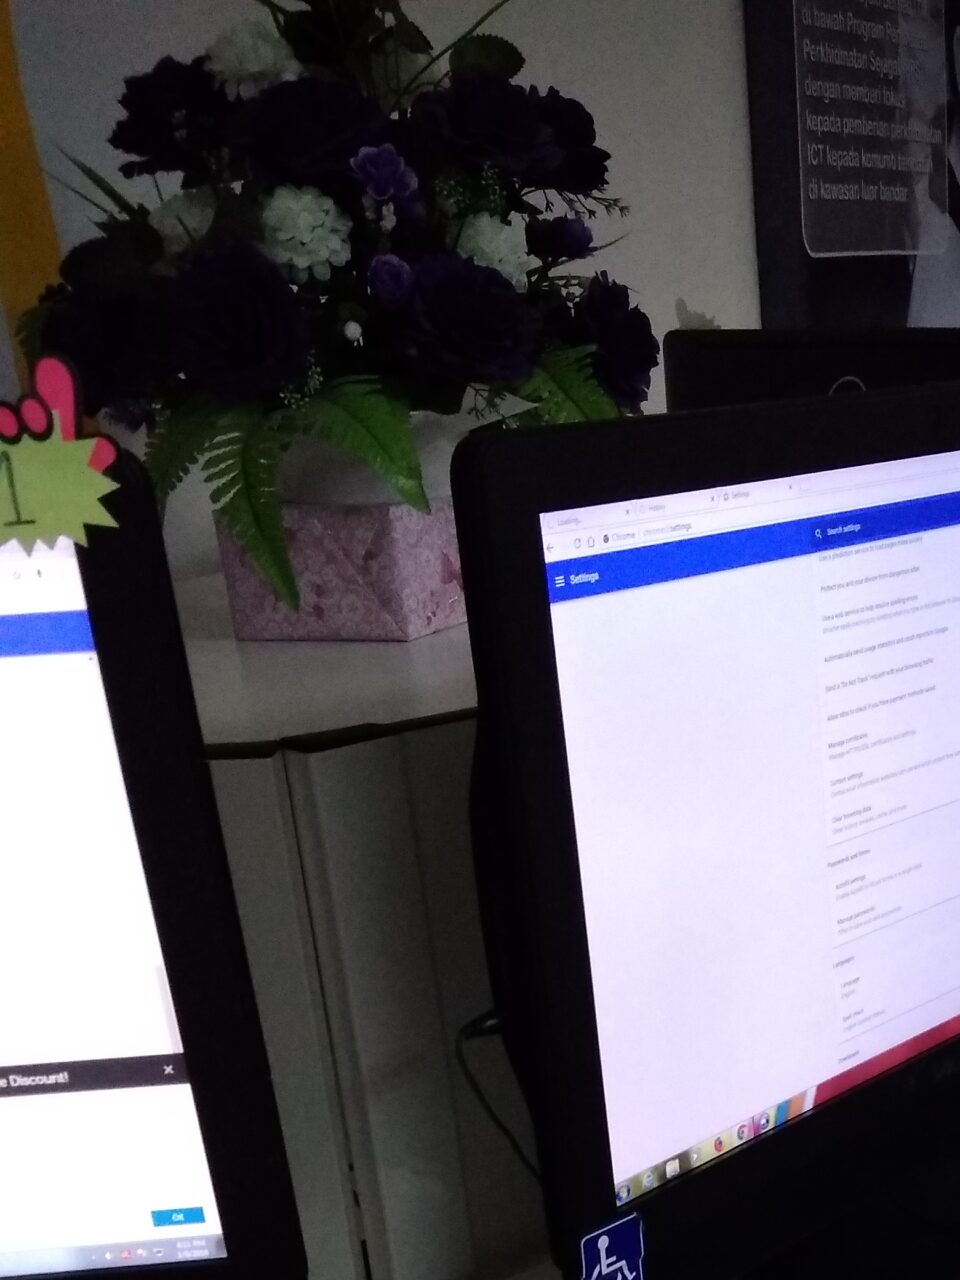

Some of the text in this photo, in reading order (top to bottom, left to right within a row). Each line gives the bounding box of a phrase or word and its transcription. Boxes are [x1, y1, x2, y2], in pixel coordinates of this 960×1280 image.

[801, 8, 812, 25] di
[813, 9, 845, 31] bawah
[847, 12, 884, 41] Program
[803, 38, 868, 68] Perkhidmatan
[804, 76, 841, 103] dengan
[806, 109, 841, 136] kepada
[807, 143, 824, 166] ICT
[826, 145, 859, 172] kepada
[808, 178, 818, 200] di
[820, 179, 860, 201] kawasan
[861, 179, 878, 201] luar
[569, 571, 600, 586] Settings
[9, 1071, 69, 1087] Discount!
